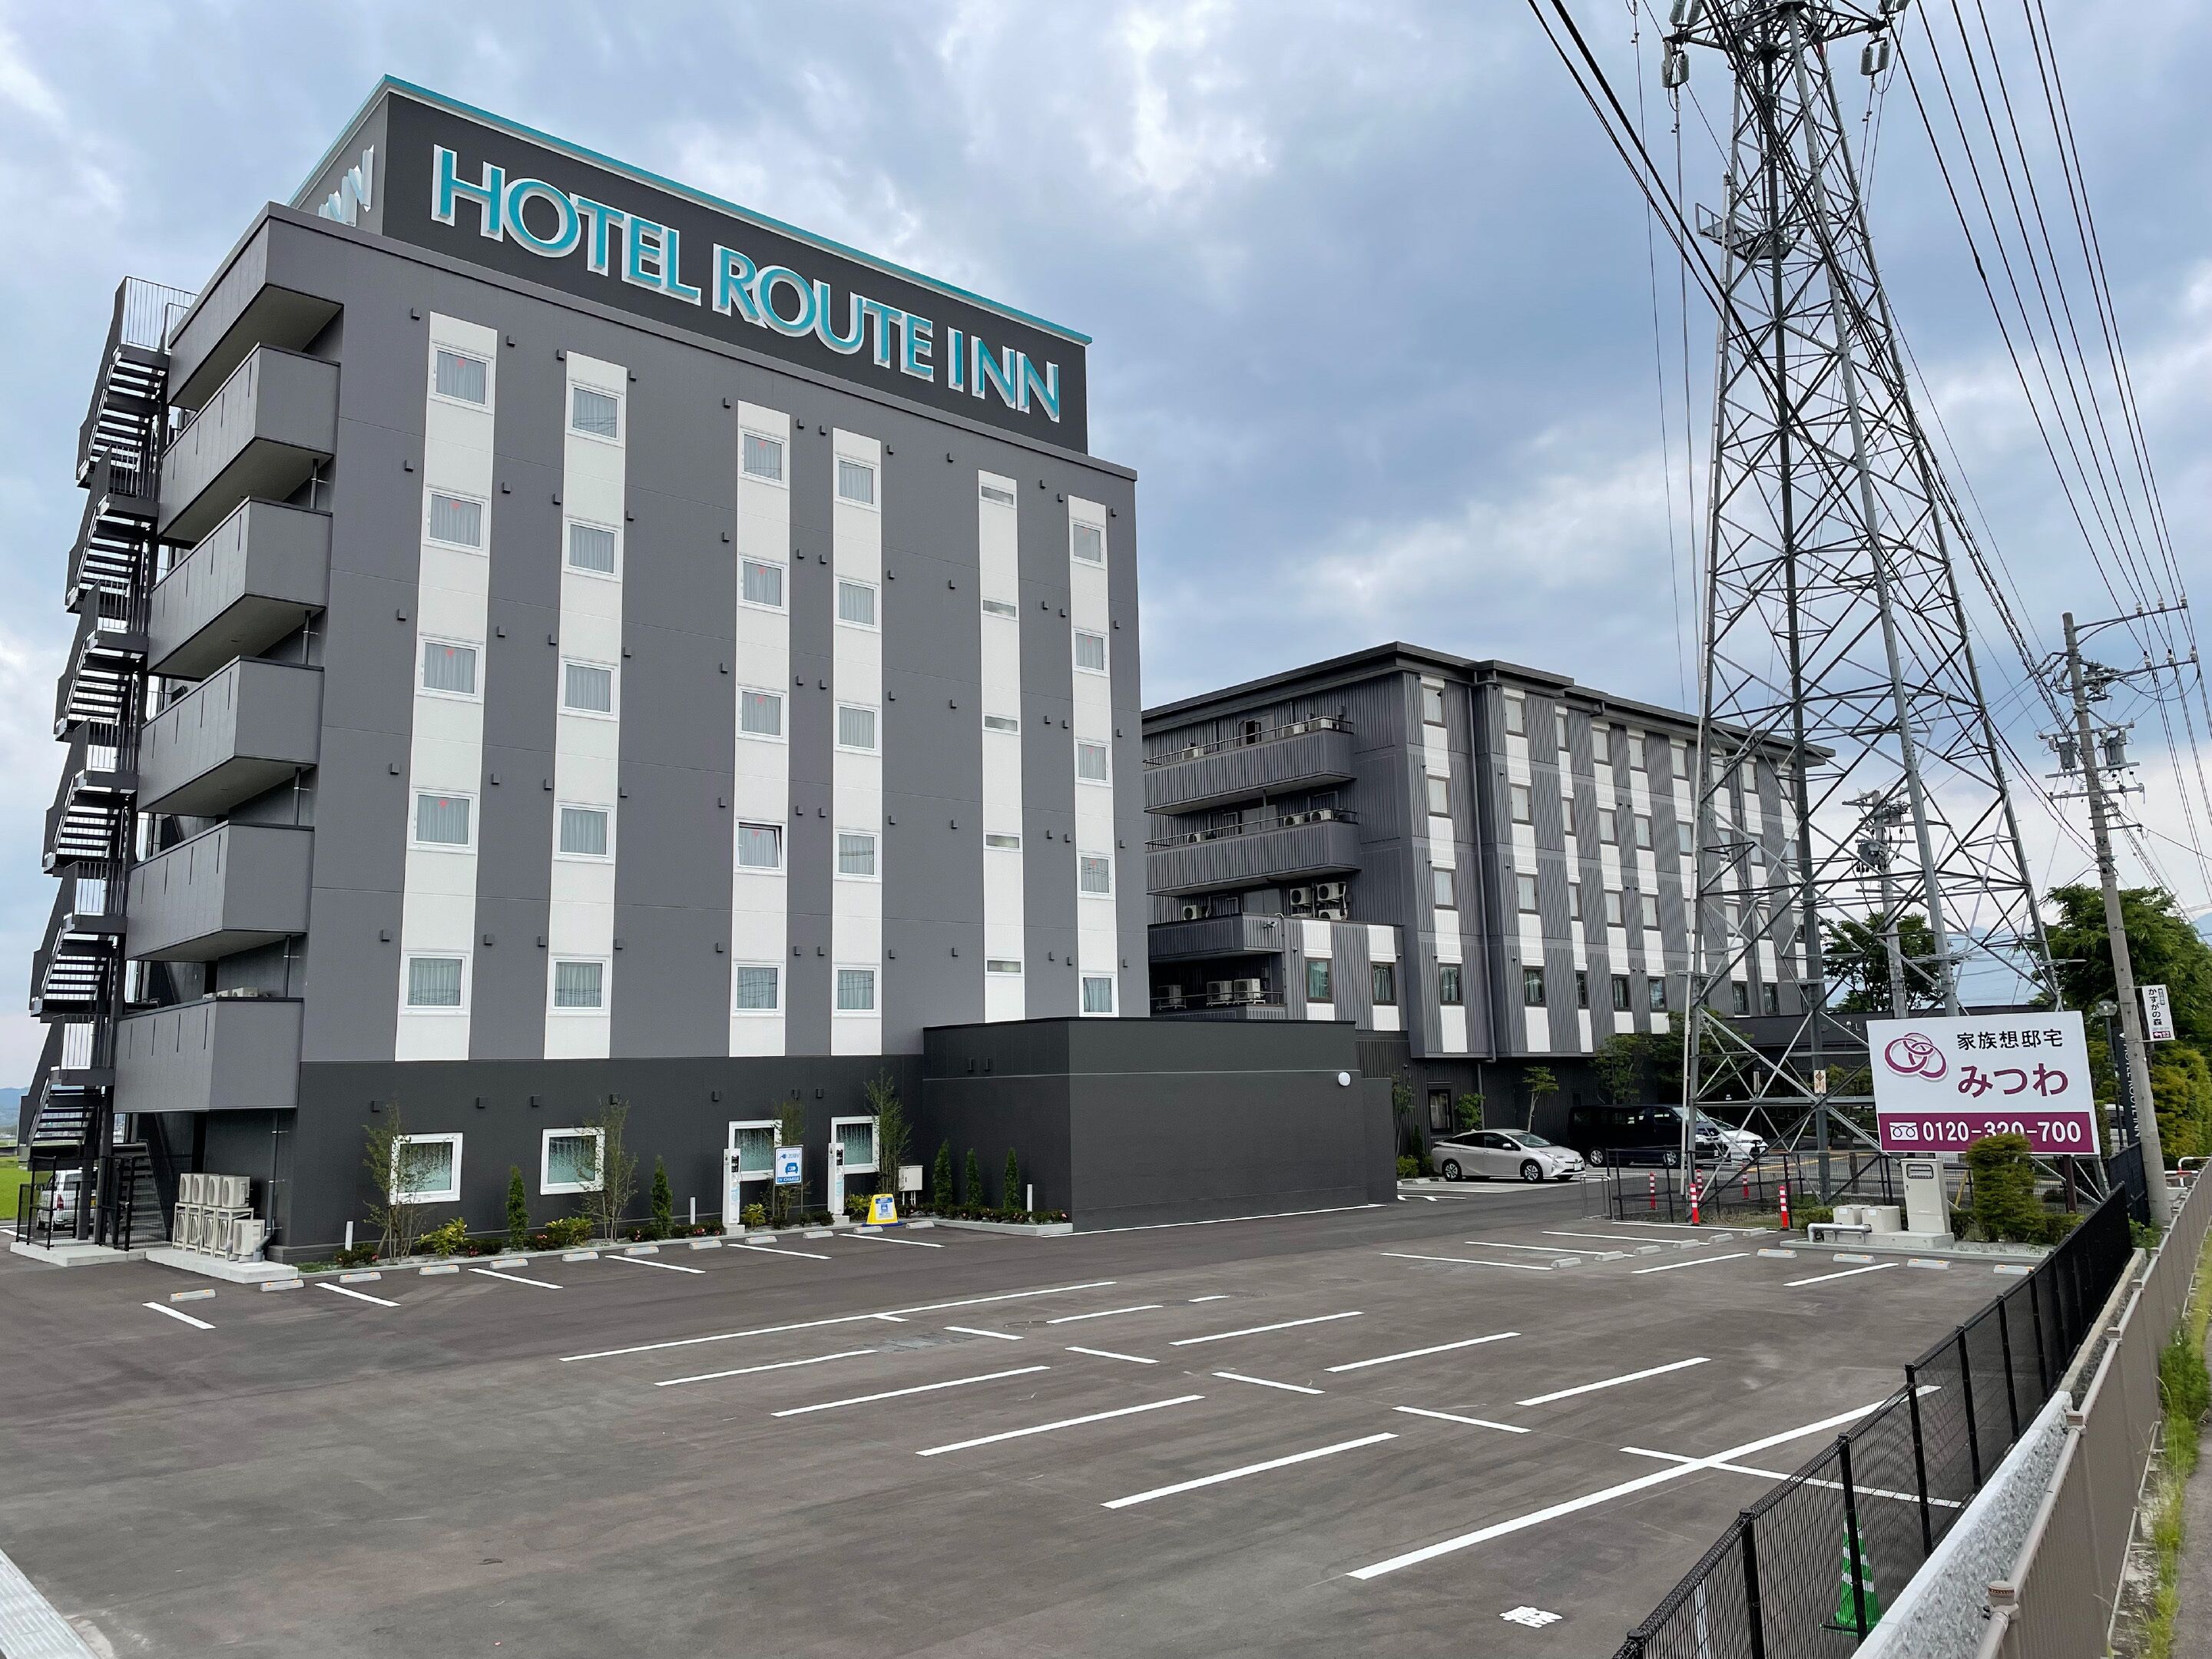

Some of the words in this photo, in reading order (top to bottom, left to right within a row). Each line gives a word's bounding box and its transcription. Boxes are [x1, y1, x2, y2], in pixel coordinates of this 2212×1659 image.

[318, 144, 374, 227] NN
[431, 144, 702, 306] HOTEL
[712, 243, 935, 383] ROUTE
[947, 326, 1060, 423] INN
[2147, 988, 2163, 1026] かすがの森
[1957, 1028, 2063, 1051] 家族想邸宅
[1958, 1062, 2068, 1098] みつわ
